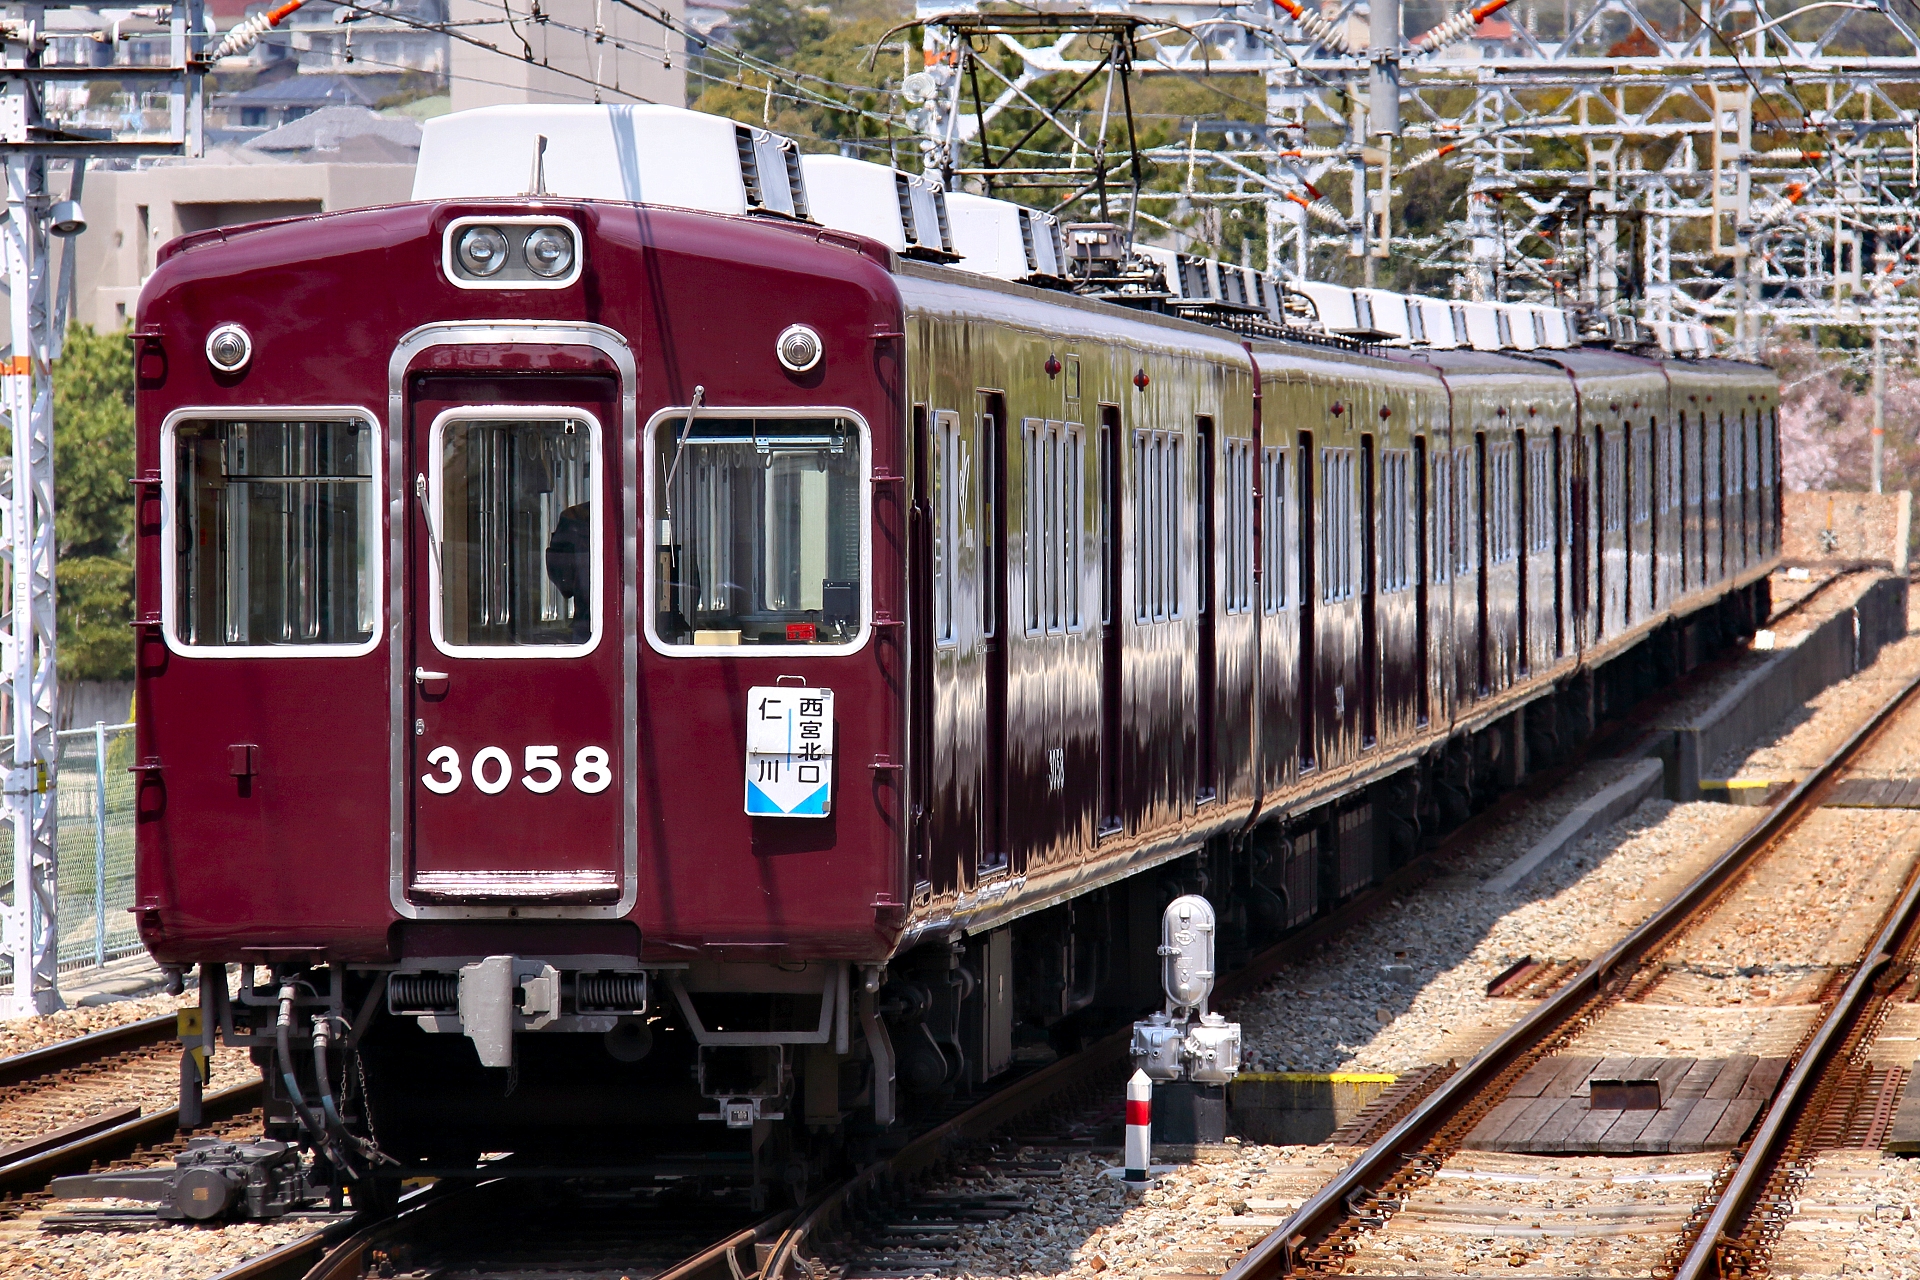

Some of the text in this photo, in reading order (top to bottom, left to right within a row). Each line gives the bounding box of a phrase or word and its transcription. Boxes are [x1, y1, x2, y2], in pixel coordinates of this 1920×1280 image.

[421, 745, 612, 794] 3058
[758, 697, 782, 783] 仁川
[797, 697, 823, 783] 西宮北口
